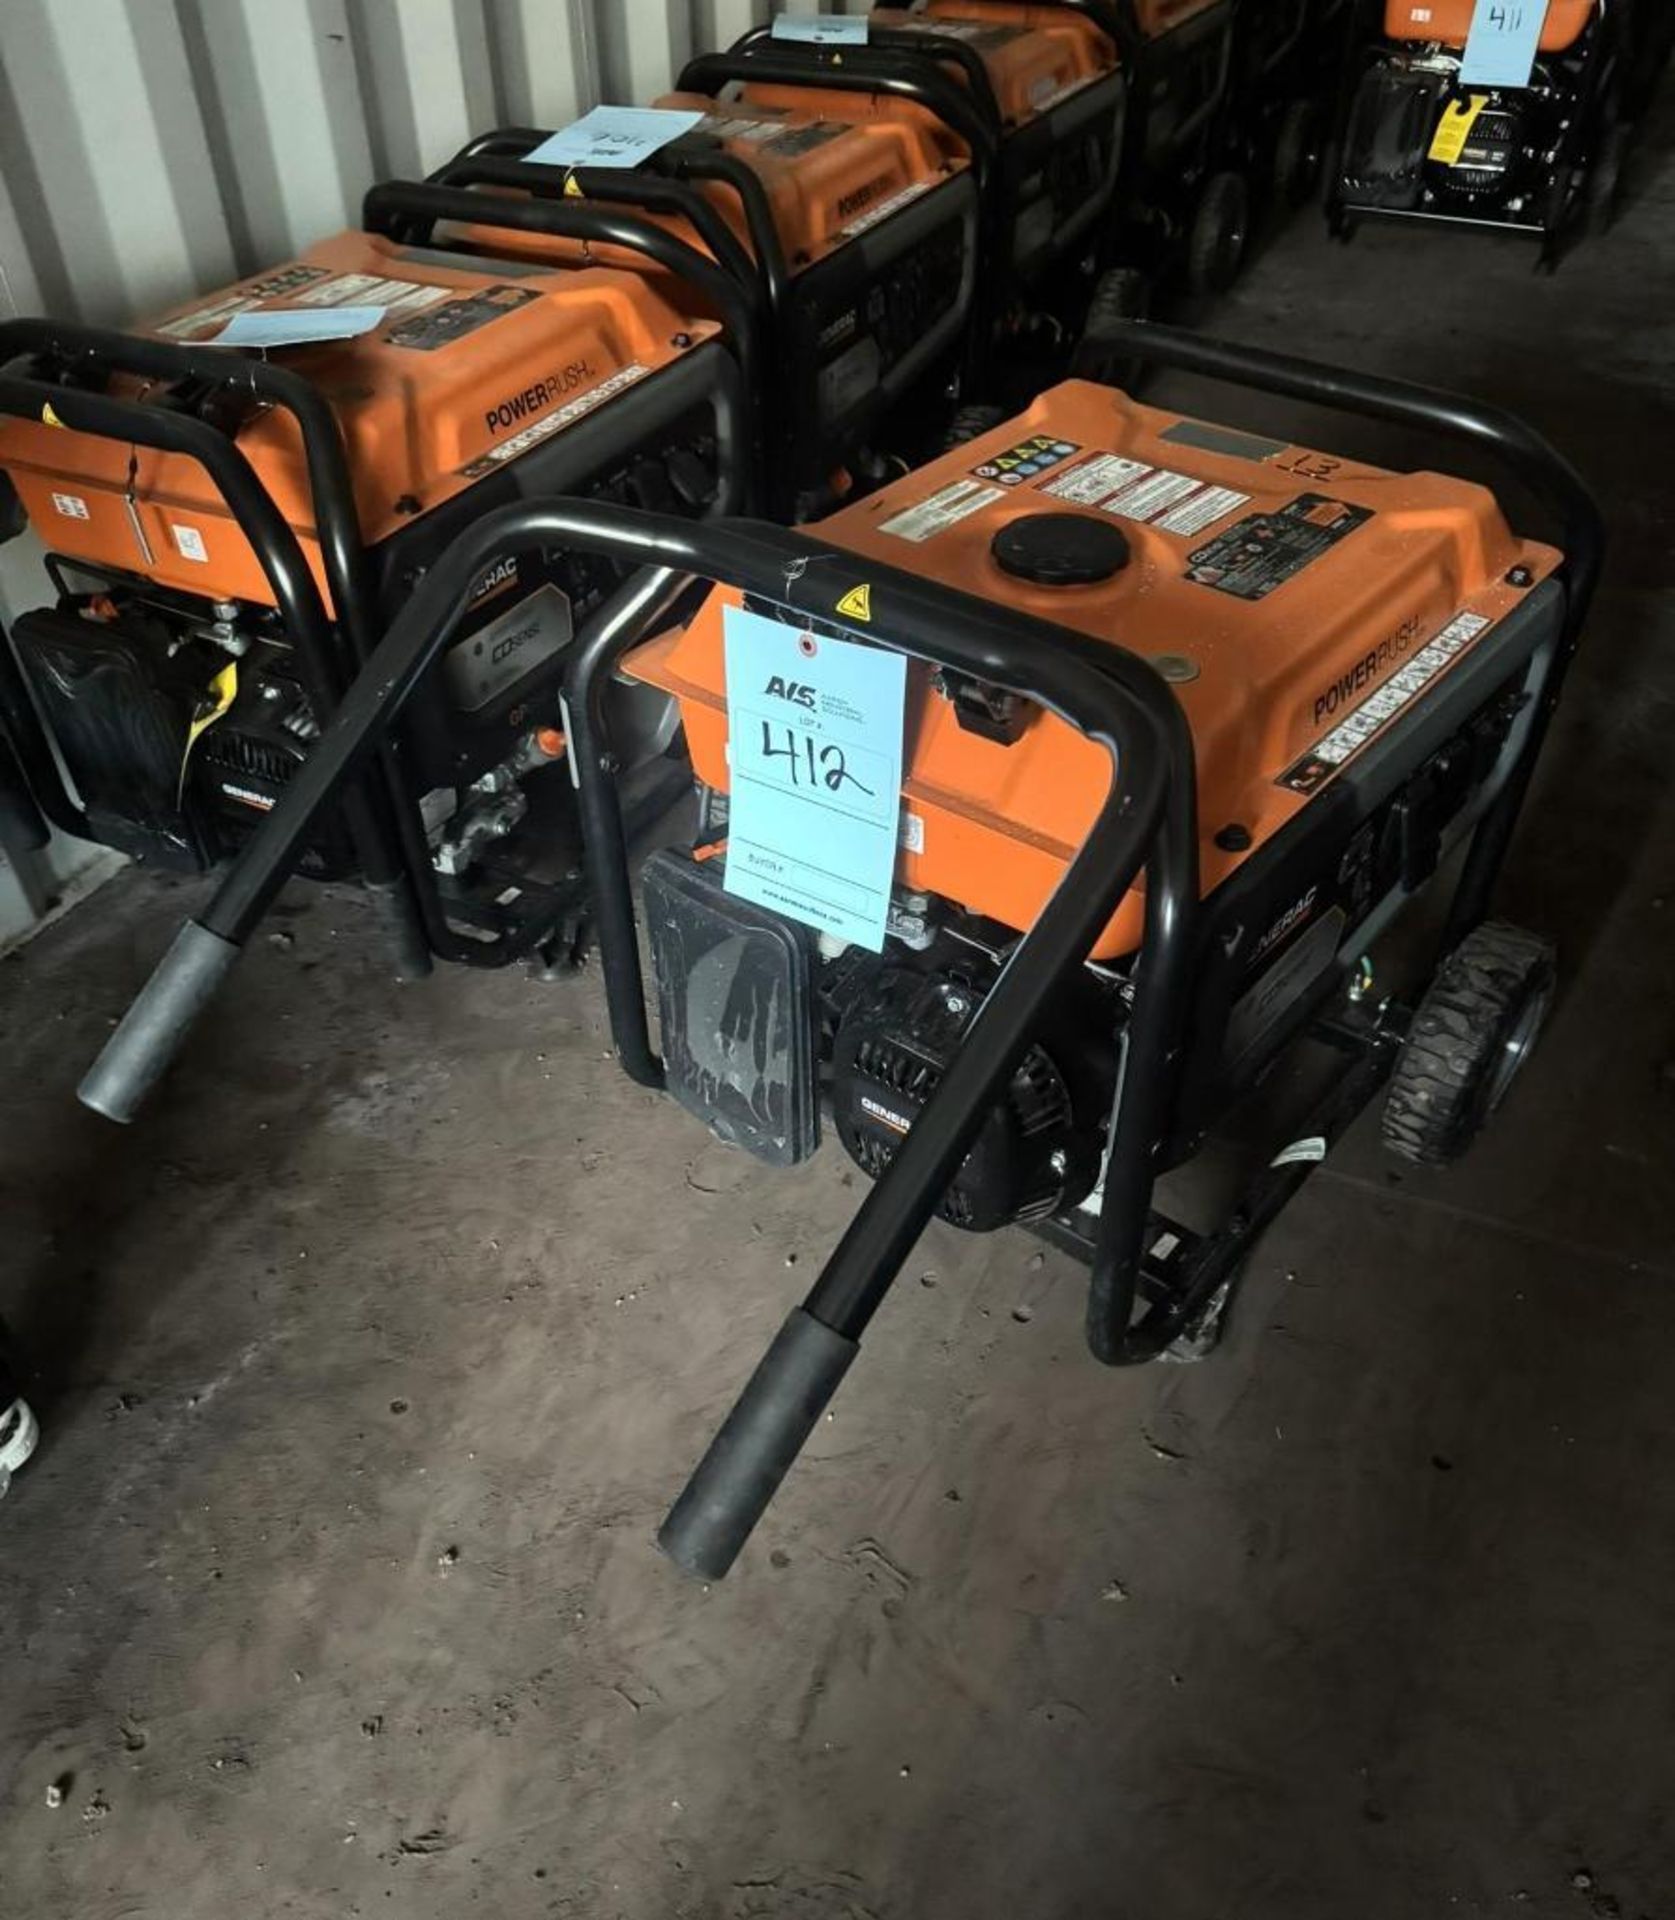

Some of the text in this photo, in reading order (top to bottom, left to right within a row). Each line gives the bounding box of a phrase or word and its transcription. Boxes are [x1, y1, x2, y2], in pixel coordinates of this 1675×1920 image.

[1490, 5, 1522, 31] 411
[485, 359, 589, 435] POWERRUSH
[1313, 615, 1420, 724] POWERRUSH
[762, 721, 875, 796] 412
